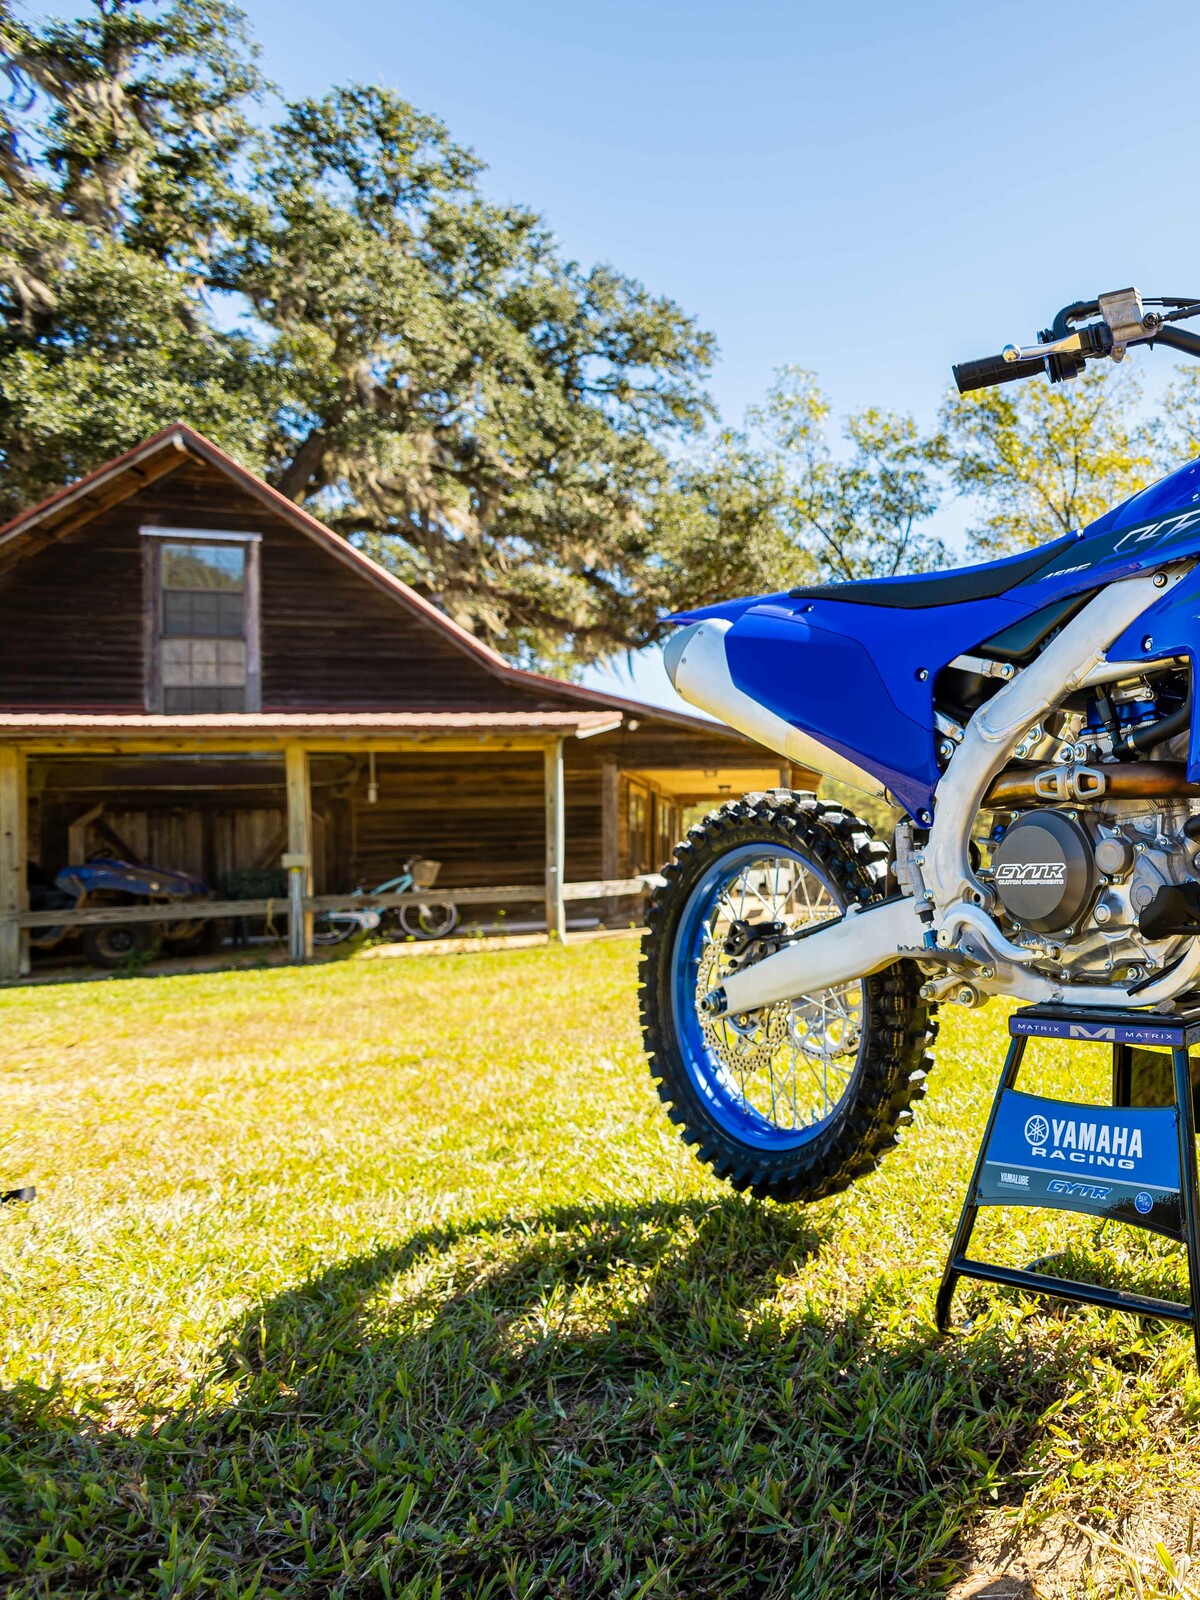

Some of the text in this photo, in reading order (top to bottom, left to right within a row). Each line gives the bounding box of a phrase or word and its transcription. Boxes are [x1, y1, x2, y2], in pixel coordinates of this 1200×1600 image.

[995, 863, 1067, 879] GYTR
[1017, 1023, 1060, 1033] MATRIX
[1125, 1031, 1173, 1040] MATRIX
[1052, 1118, 1143, 1159] YAMAHA
[1031, 1146, 1135, 1170] RACING
[1000, 1172, 1030, 1186] YAMALUBE
[1046, 1179, 1111, 1200] GYTR
